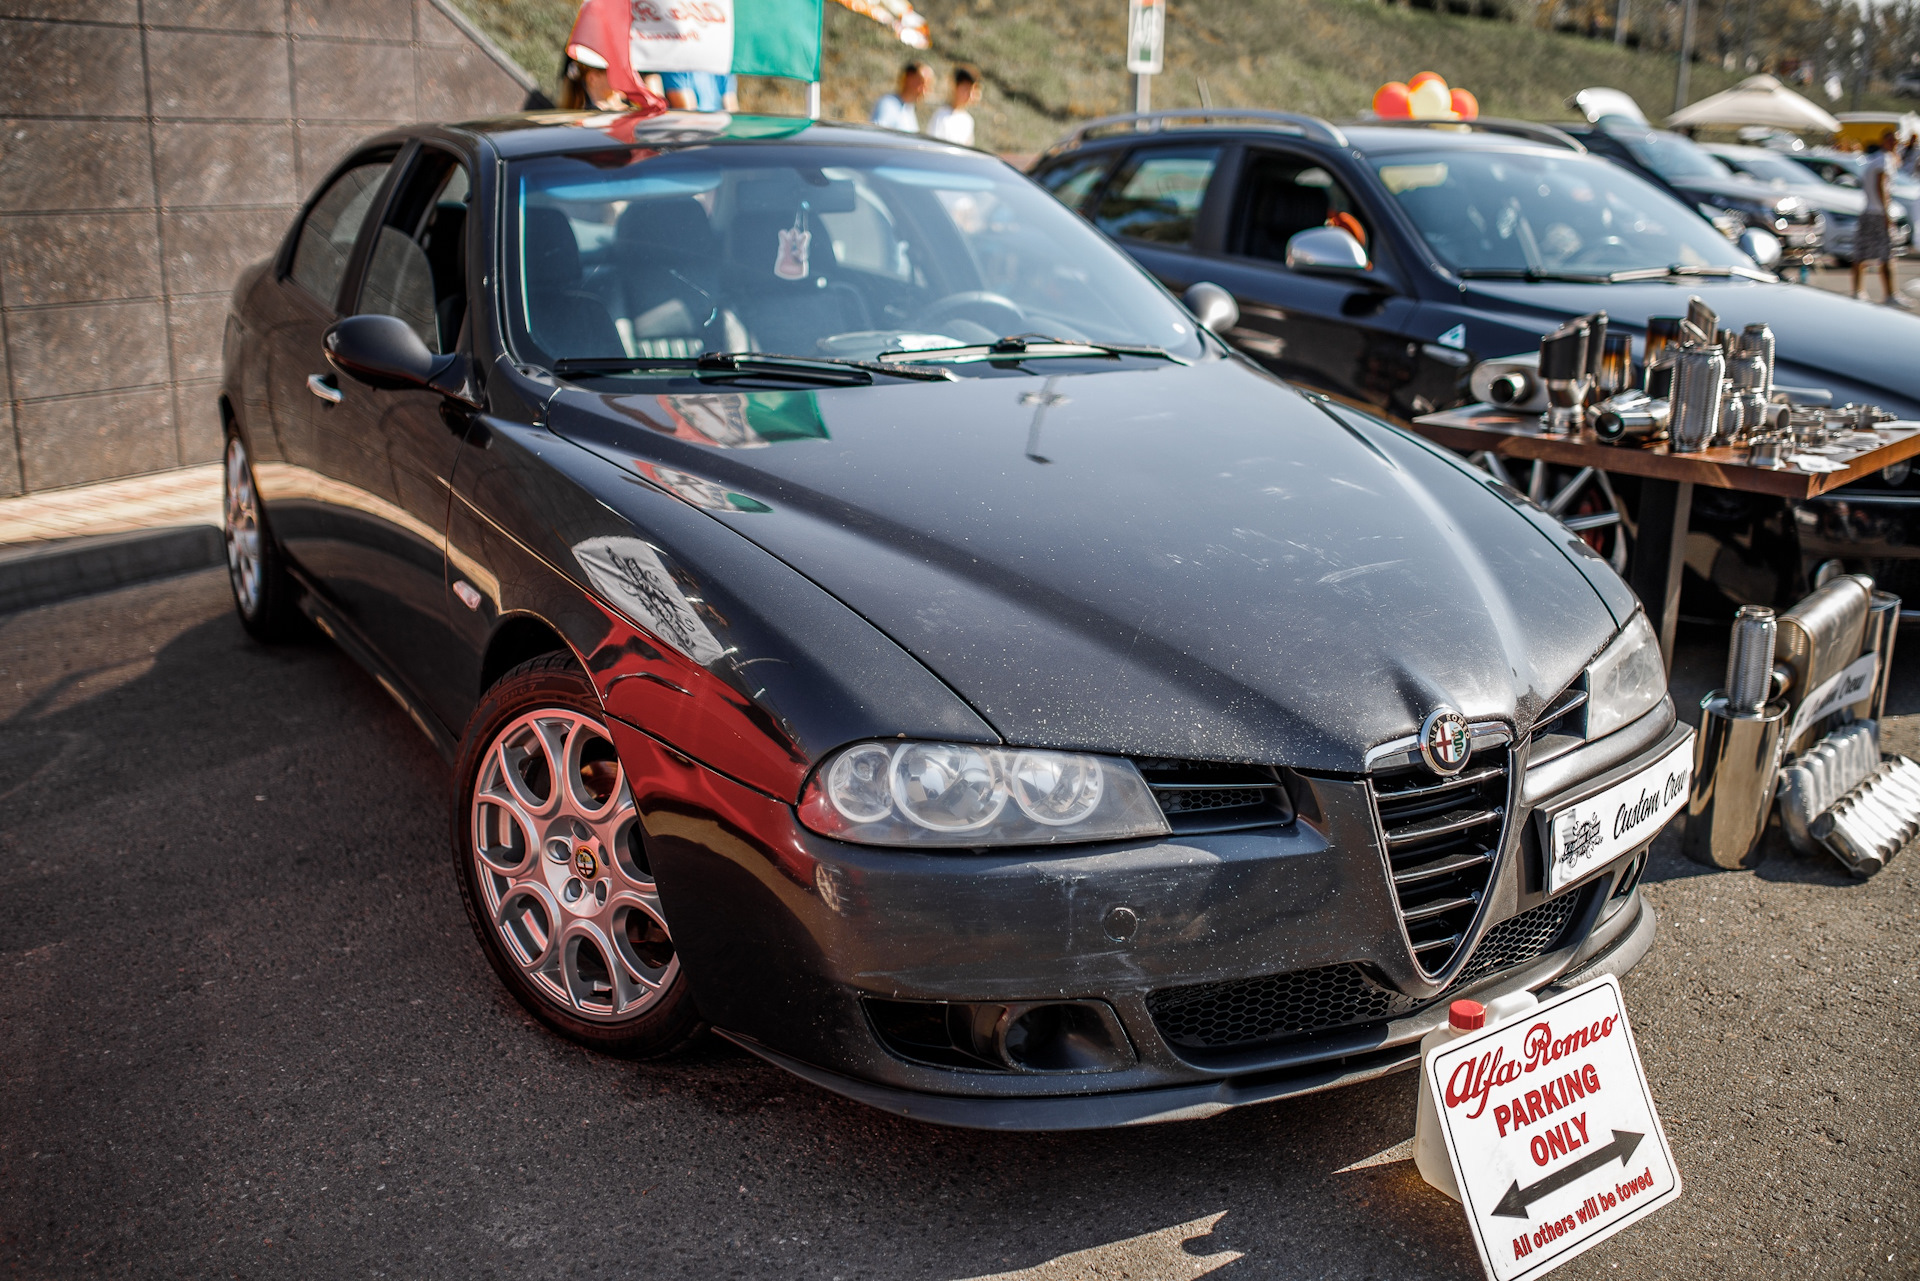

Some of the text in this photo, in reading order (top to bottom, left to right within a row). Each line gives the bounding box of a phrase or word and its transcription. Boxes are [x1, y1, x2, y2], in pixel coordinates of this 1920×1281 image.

[1429, 714, 1471, 747] ALFA ROMEO
[1613, 788, 1660, 840] Custom
[1663, 768, 1688, 807] Crew
[1445, 1013, 1618, 1119] Alfa Romeo
[1493, 1064, 1601, 1138] PARKING
[1530, 1112, 1590, 1167] ONLY
[1512, 1167, 1654, 1260] All others will be towed
